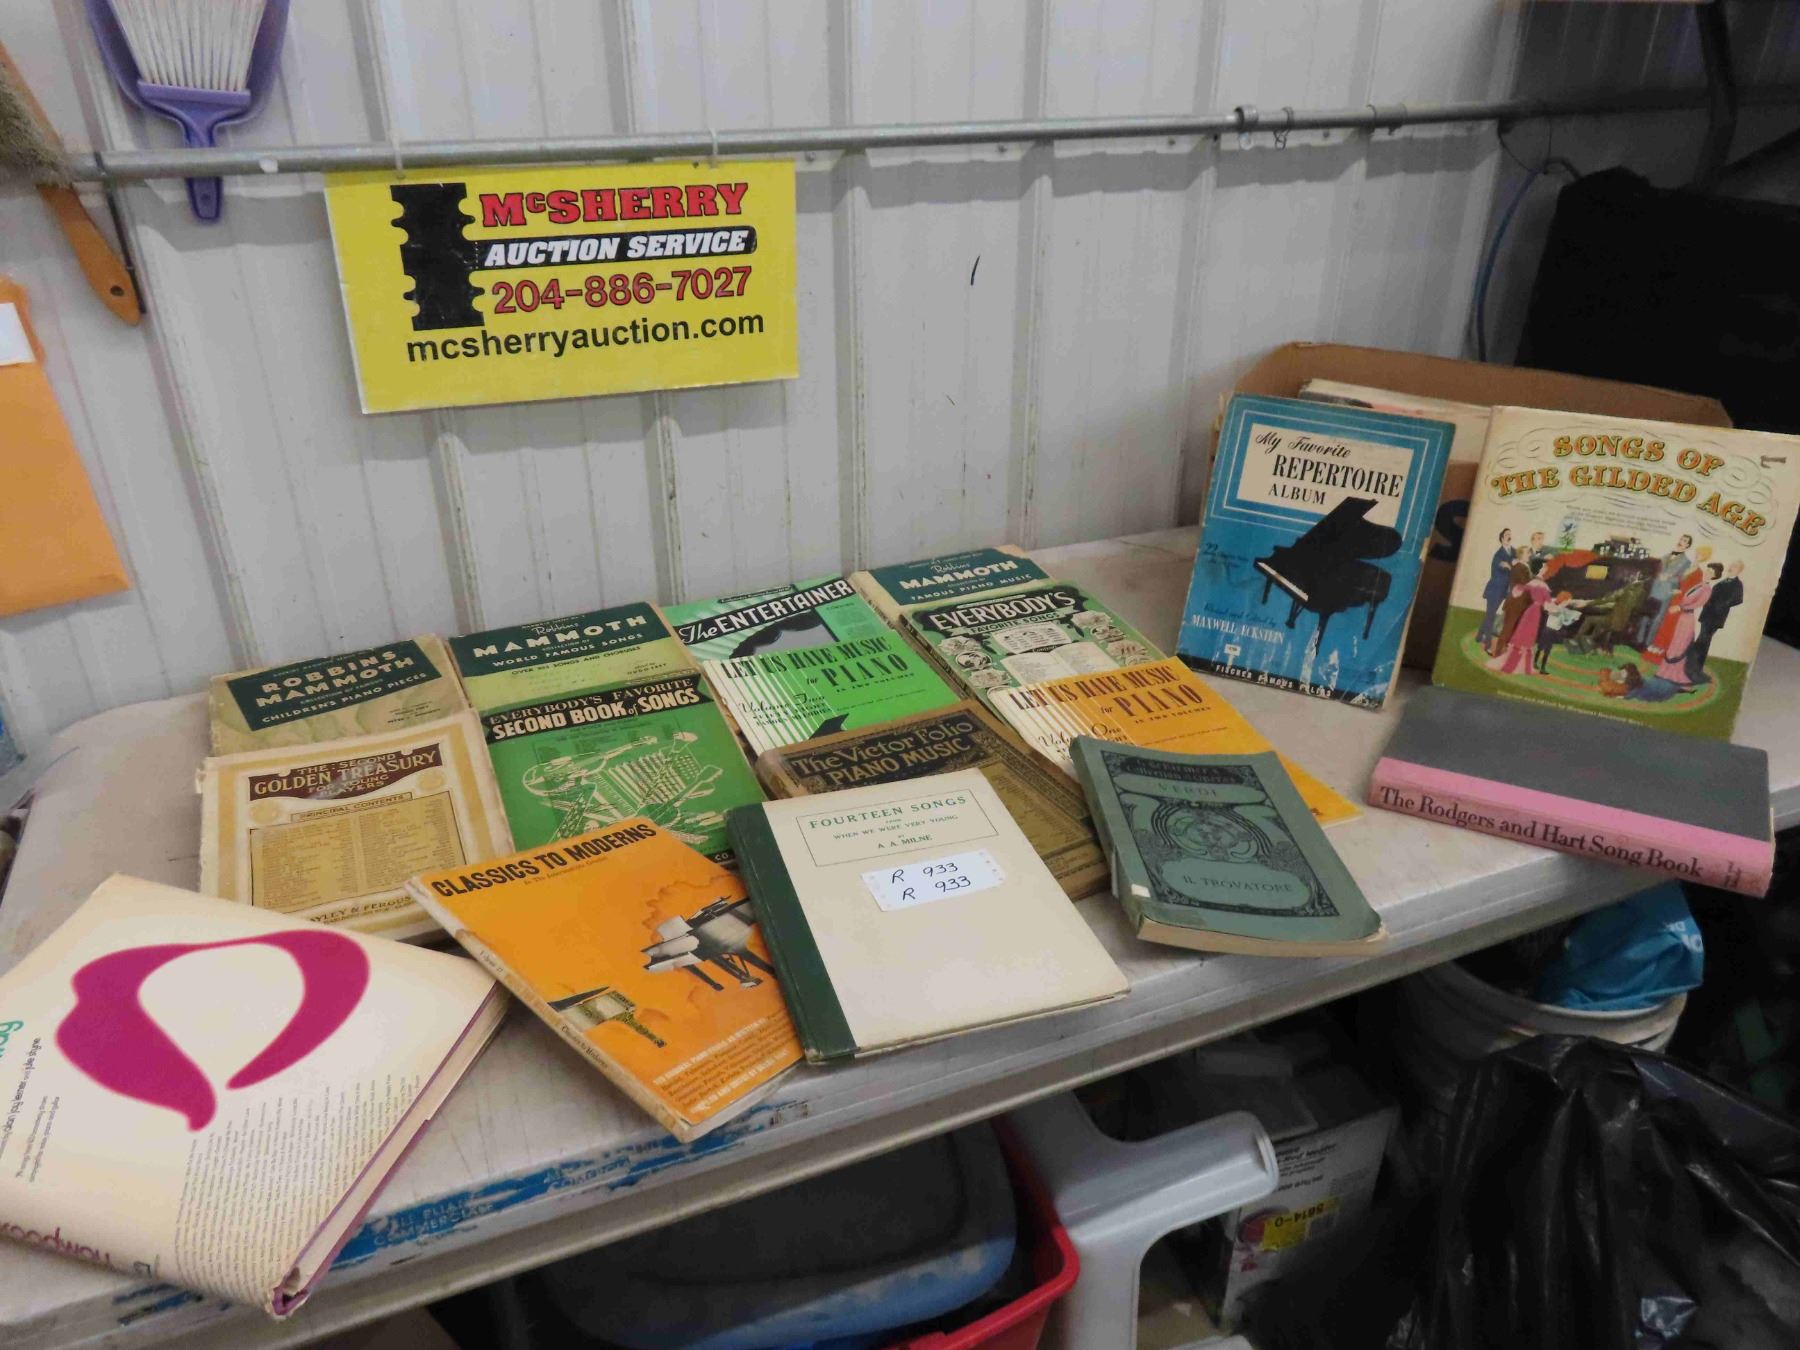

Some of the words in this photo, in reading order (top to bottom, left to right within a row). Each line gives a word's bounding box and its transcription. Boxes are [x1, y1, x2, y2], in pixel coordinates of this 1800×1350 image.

[479, 183, 749, 227] McSHERRY
[484, 240, 620, 267] AUCTION
[626, 230, 748, 258] SERVICE
[491, 266, 753, 314] 204-886-7027
[406, 314, 765, 362] mcsherryauction.com
[1255, 432, 1282, 454] My
[1288, 435, 1352, 459] Favorite
[1553, 434, 1665, 462] SONGS
[1676, 448, 1725, 477] OF
[1268, 483, 1326, 505] ALBUM
[1272, 454, 1404, 498] REPERTOIRE
[1490, 466, 1560, 498] THE
[1569, 465, 1697, 503] GILDED
[1696, 491, 1766, 536] AGE
[900, 560, 1018, 590] MAMMOTH
[911, 588, 954, 601] FAMOUS
[959, 581, 994, 593] PIANO
[1000, 573, 1033, 585] MUSIC
[678, 624, 718, 644] The
[717, 578, 853, 634] ENTERTAINER
[929, 591, 1076, 631] EVERYBODY'S
[970, 618, 1022, 634] FAVORITE
[1023, 611, 1061, 625] SONGS
[472, 615, 648, 659] MAMMOTH
[1191, 614, 1236, 634] MAXWELL
[1240, 623, 1285, 645] ECKSTEIN
[492, 653, 539, 667] WORLD
[545, 644, 597, 659] FAMOUS
[602, 633, 644, 648] SONGS
[552, 658, 581, 668] SONGS
[583, 654, 600, 662] AND
[720, 658, 757, 680] LET
[764, 651, 788, 675] US
[787, 646, 838, 670] HAVE
[836, 635, 893, 660] MUSIC
[255, 657, 415, 708] MAMMOTH
[261, 651, 397, 693] ROBBINS
[806, 676, 819, 687] for
[820, 653, 909, 688] PIANO
[1009, 686, 1050, 711] LET
[1052, 681, 1078, 706] US
[1076, 674, 1130, 699] HAVE
[1125, 664, 1181, 690] MUSIC
[1215, 664, 1252, 679] FISCHER
[262, 700, 337, 723] CHILDREN'S
[341, 686, 383, 703] PIANO
[387, 672, 428, 690] PIECES
[489, 695, 603, 726] EVERYBODY'S
[613, 677, 693, 700] FAVORITE
[491, 711, 567, 740] SECOND
[570, 700, 628, 728] BOOK
[627, 703, 639, 717] of
[636, 687, 700, 714] SONGS
[1100, 705, 1113, 716] for
[1113, 683, 1205, 718] PIANO
[297, 763, 329, 775] THE
[338, 752, 396, 769] SECOND
[793, 752, 842, 777] The
[843, 736, 915, 765] Victor
[913, 721, 974, 747] Folio
[825, 756, 900, 785] PIANO
[903, 737, 971, 768] MUSIC
[254, 771, 332, 796] GOLDEN
[338, 750, 438, 781] TREASURY
[307, 782, 336, 794] FOR
[338, 773, 391, 789] YOUNG
[321, 780, 386, 798] PLAYERS
[1157, 783, 1218, 796] VERDI
[300, 805, 350, 820] PRINCIPAL
[353, 794, 405, 811] CONTENTS
[810, 806, 903, 829] FOURTEEN
[910, 796, 967, 813] SONGS
[833, 830, 861, 840] WHEN
[862, 828, 875, 836] WE
[878, 823, 902, 833] WERE
[904, 819, 927, 829] VERY
[928, 814, 959, 825] YOUNG
[902, 834, 933, 845] MILNE
[1380, 786, 1415, 809] The
[1419, 796, 1495, 830] Rodgers
[1499, 818, 1536, 839] and
[1541, 824, 1586, 850] Hart
[1588, 834, 1644, 867] Song
[1646, 847, 1705, 878] Book
[431, 857, 541, 898] CLASSICS
[535, 851, 568, 871] TO
[563, 824, 657, 863] MODERNS
[891, 868, 905, 884] R
[922, 862, 959, 878] 933
[902, 887, 917, 901] R
[934, 875, 972, 893] 933
[1182, 874, 1198, 886] IL
[1201, 877, 1293, 893] TROVATORE
